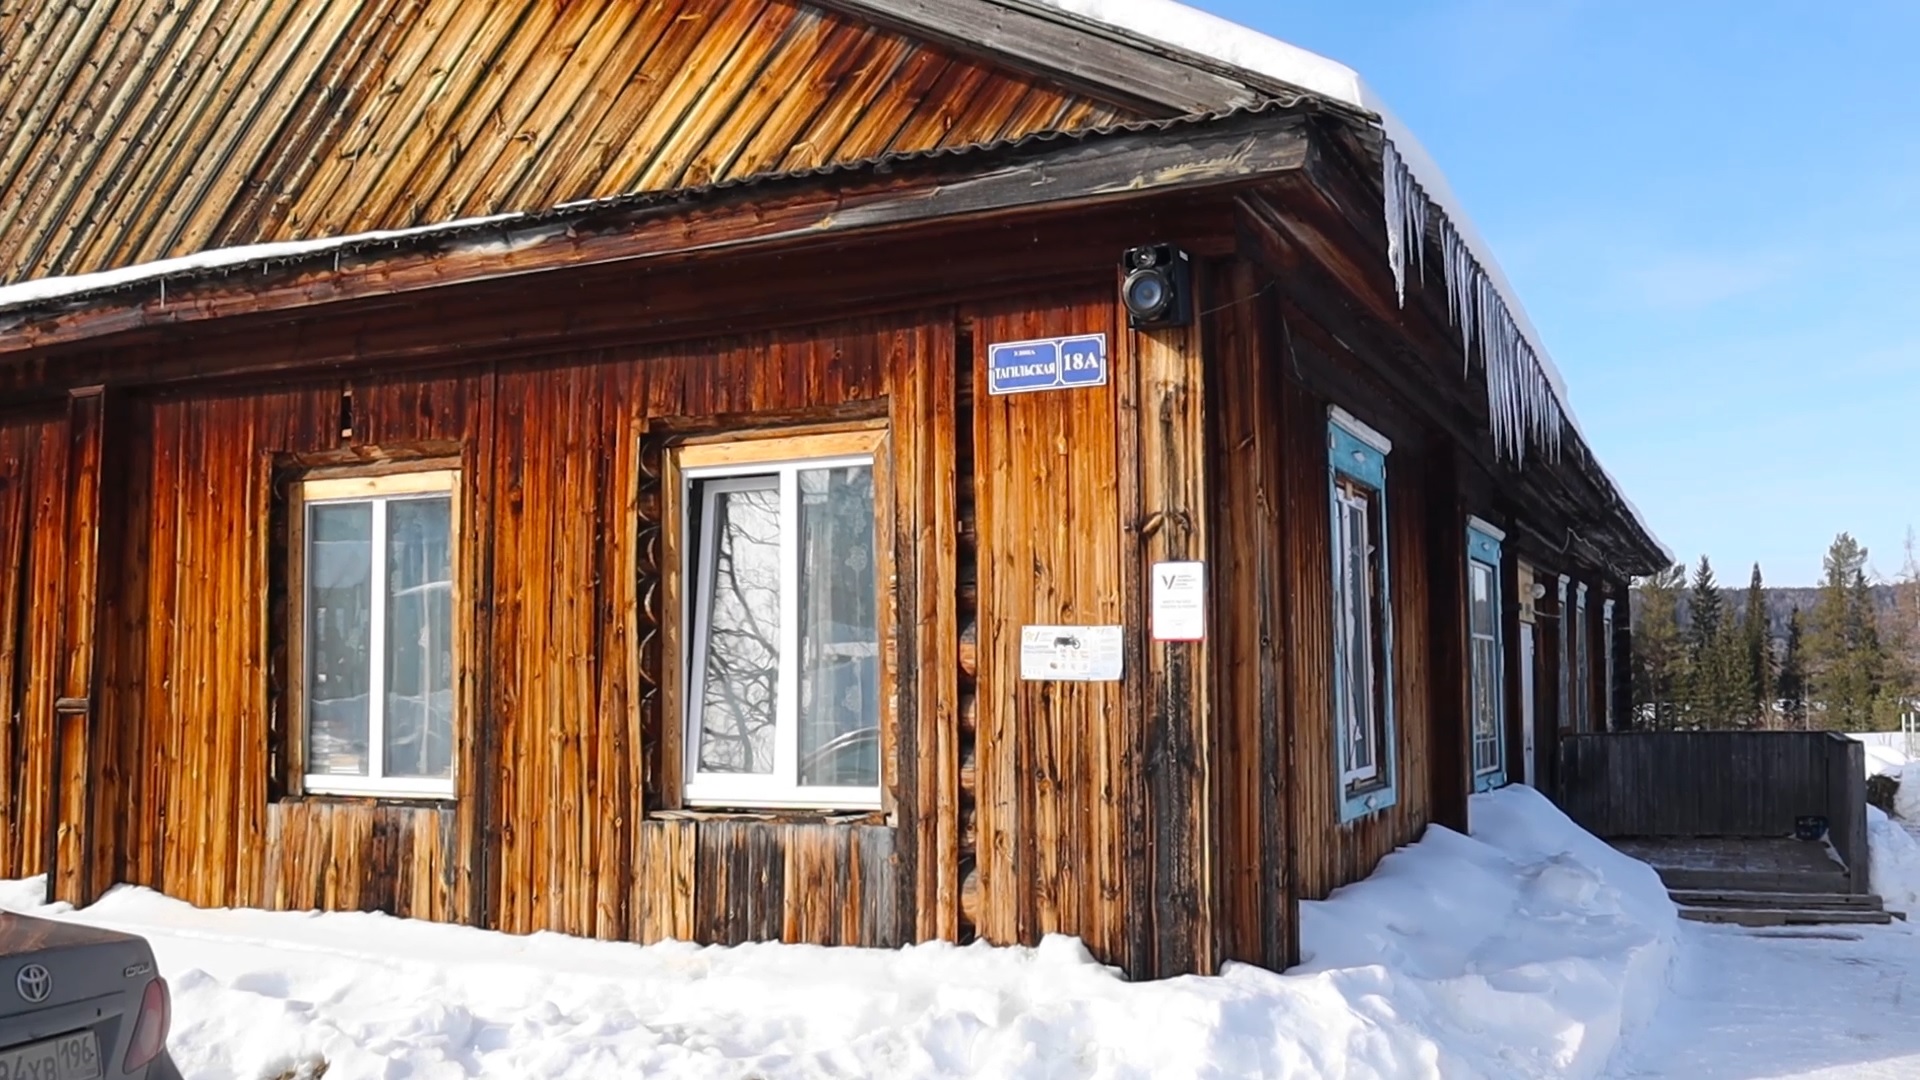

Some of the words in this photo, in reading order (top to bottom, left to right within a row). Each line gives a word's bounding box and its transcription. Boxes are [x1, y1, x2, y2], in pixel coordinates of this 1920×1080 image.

[995, 362, 1056, 380] ТАГИЛЬСКАЯ
[1064, 352, 1099, 371] 18А
[60, 1036, 92, 1070] 196
